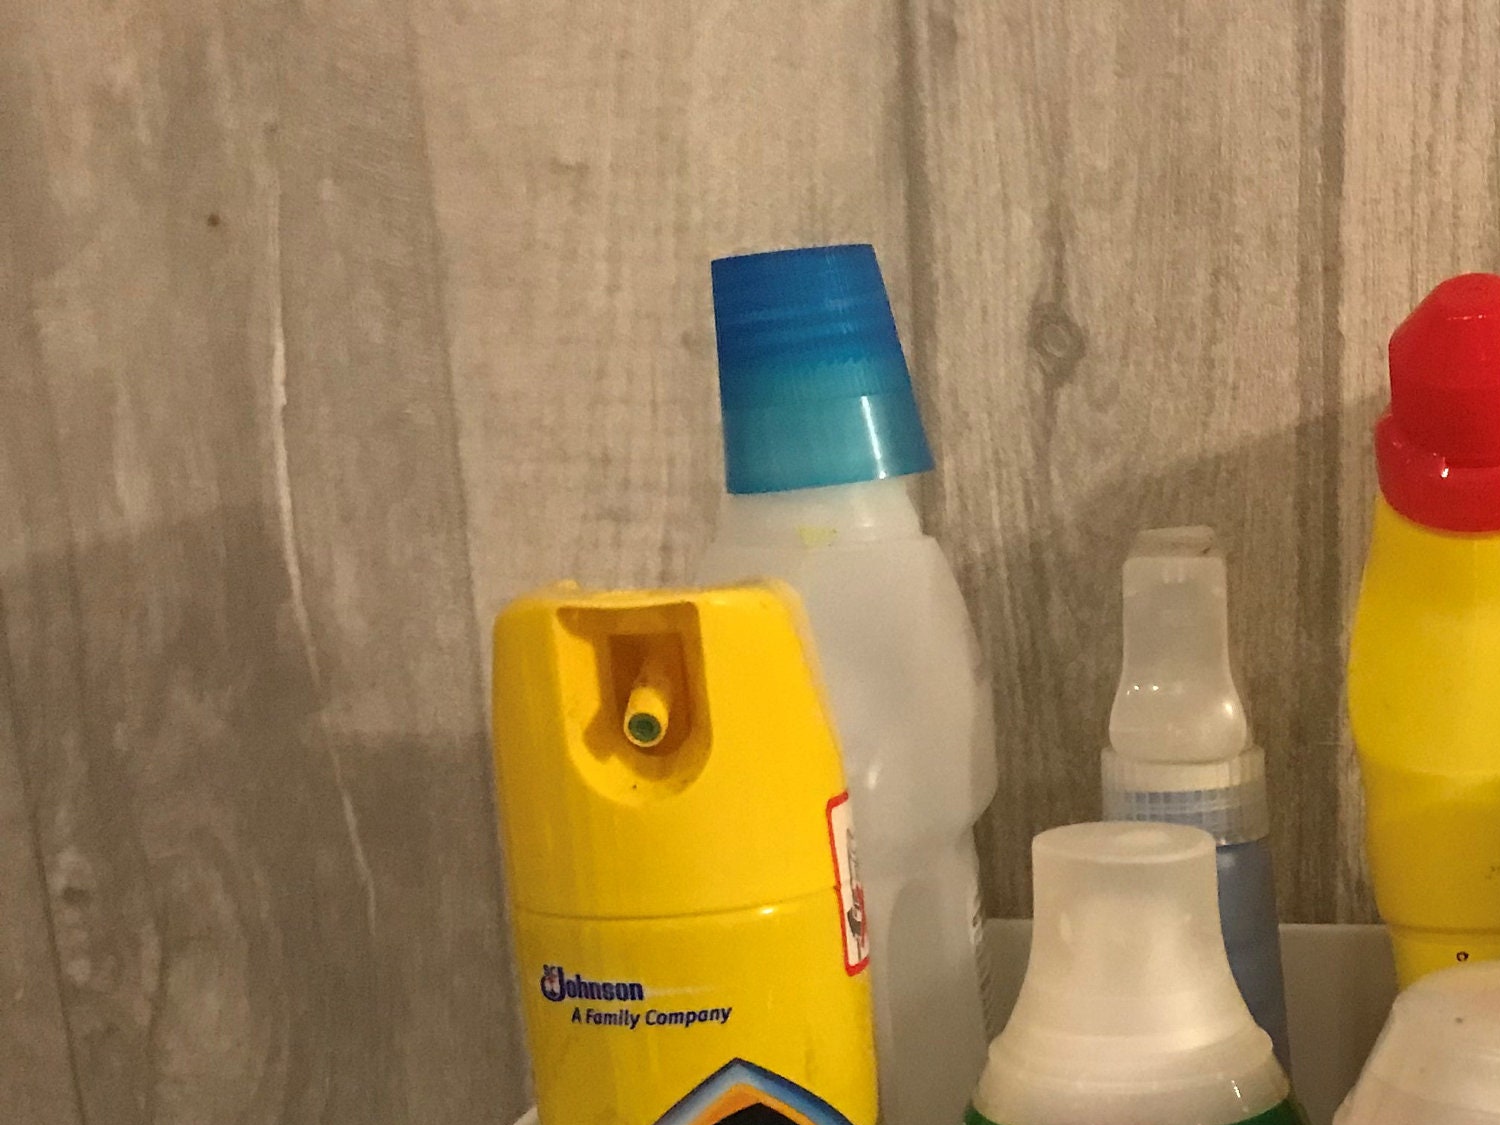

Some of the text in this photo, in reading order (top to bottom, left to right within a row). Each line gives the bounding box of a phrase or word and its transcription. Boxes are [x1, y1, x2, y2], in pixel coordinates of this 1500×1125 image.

[540, 966, 645, 1002] Johnson
[571, 1006, 733, 1030] A Family Company
